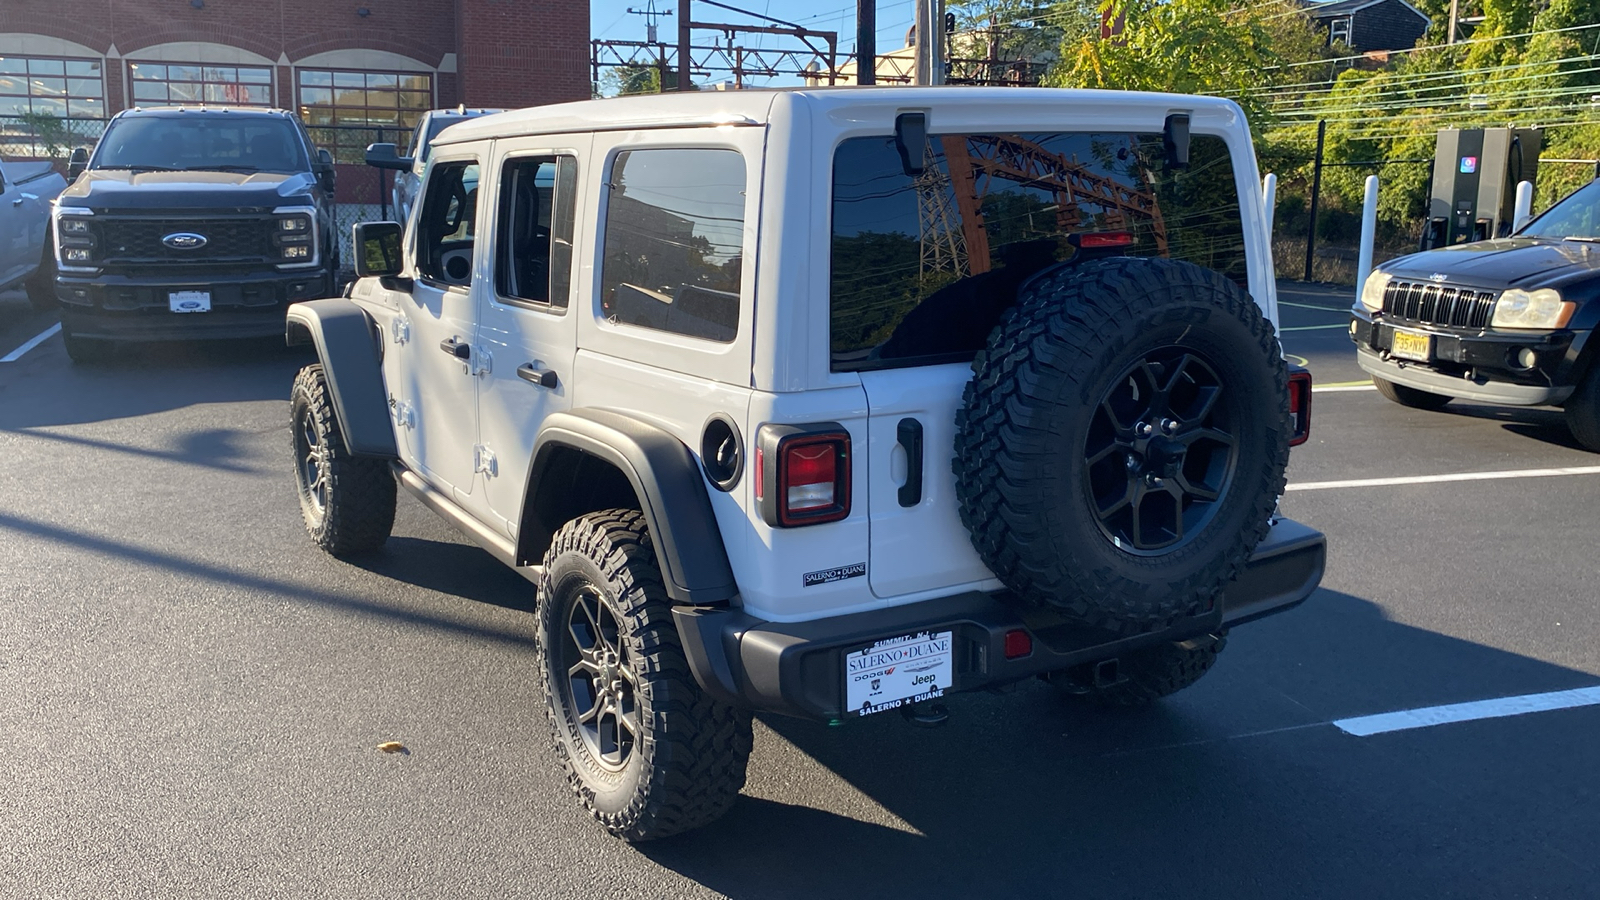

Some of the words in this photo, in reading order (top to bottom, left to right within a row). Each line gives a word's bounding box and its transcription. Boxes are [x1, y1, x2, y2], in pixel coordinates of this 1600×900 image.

[806, 571, 837, 582] SALERNO
[842, 565, 865, 576] DUANE
[849, 650, 903, 671] SALERNO
[909, 640, 949, 658] DUANE
[854, 670, 888, 682] DODGE
[911, 674, 936, 686] Jeep
[859, 700, 902, 716] SALERNO
[914, 689, 944, 702] DUANE
